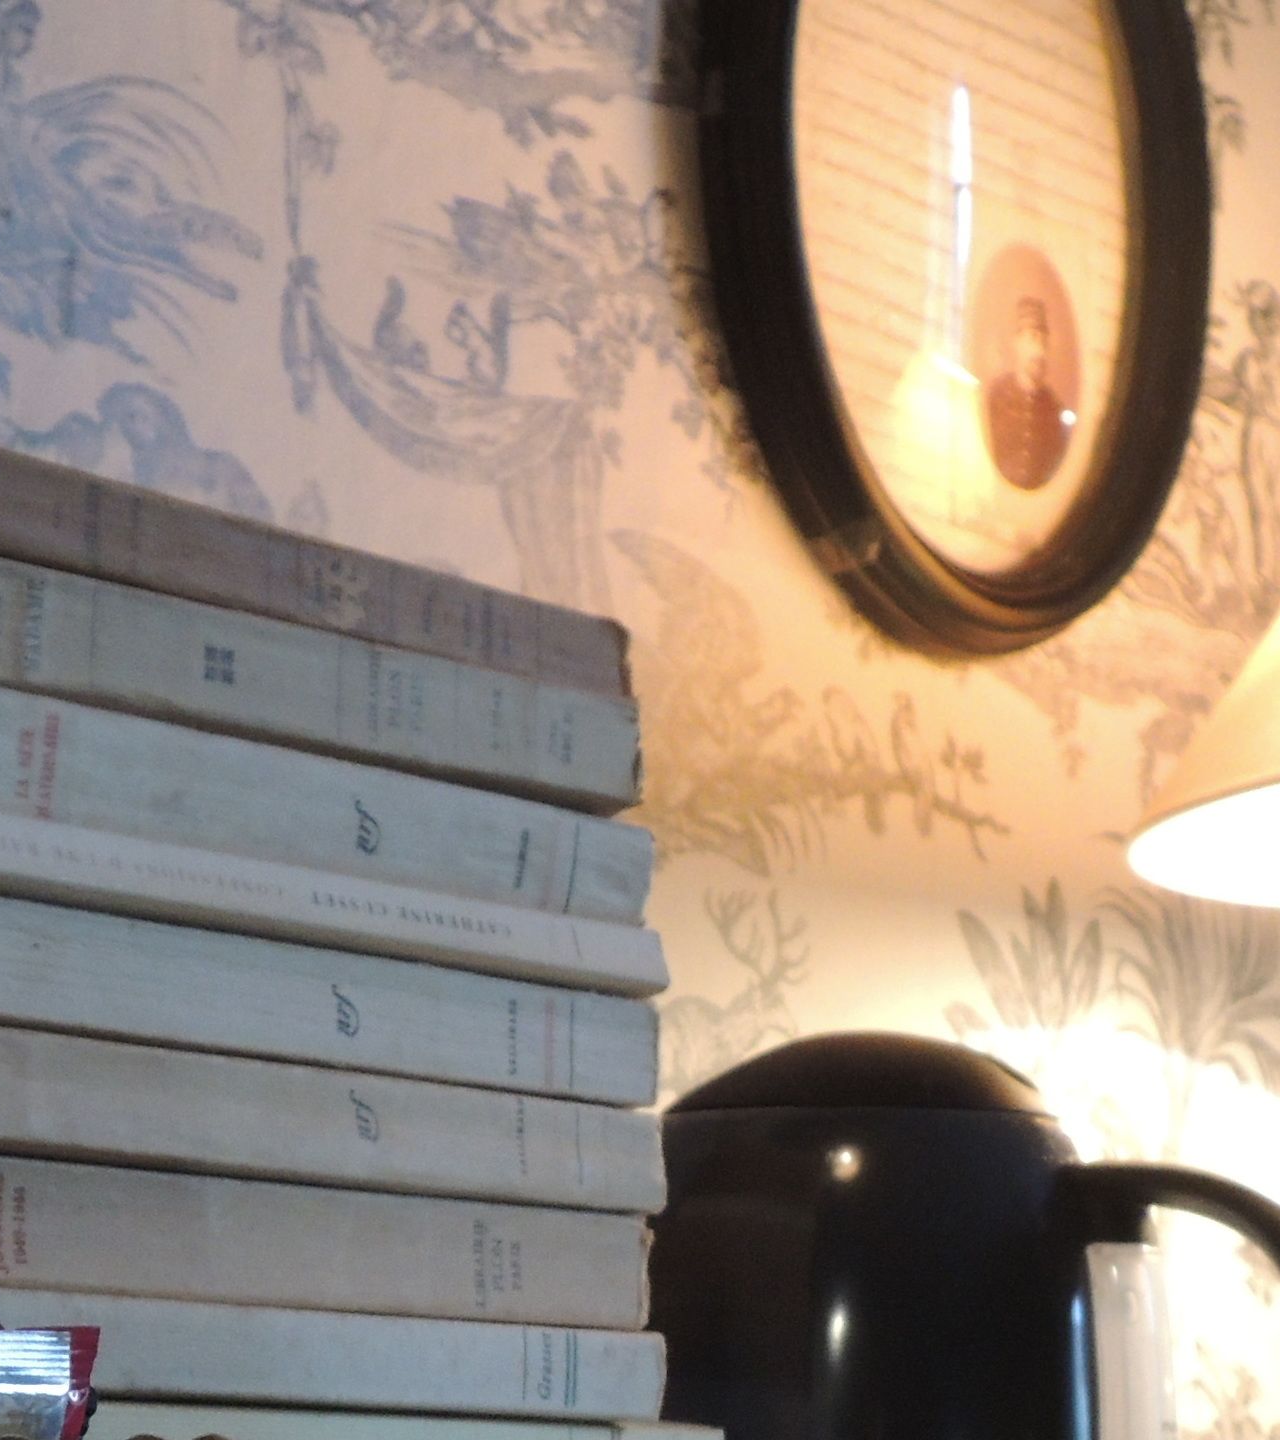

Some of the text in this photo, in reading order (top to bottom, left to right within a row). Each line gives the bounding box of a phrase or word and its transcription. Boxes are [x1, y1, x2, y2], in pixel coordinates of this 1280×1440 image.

[492, 1238, 504, 1292] PLON
[510, 1241, 521, 1291] PARIS
[537, 1332, 552, 1400] Grasset
